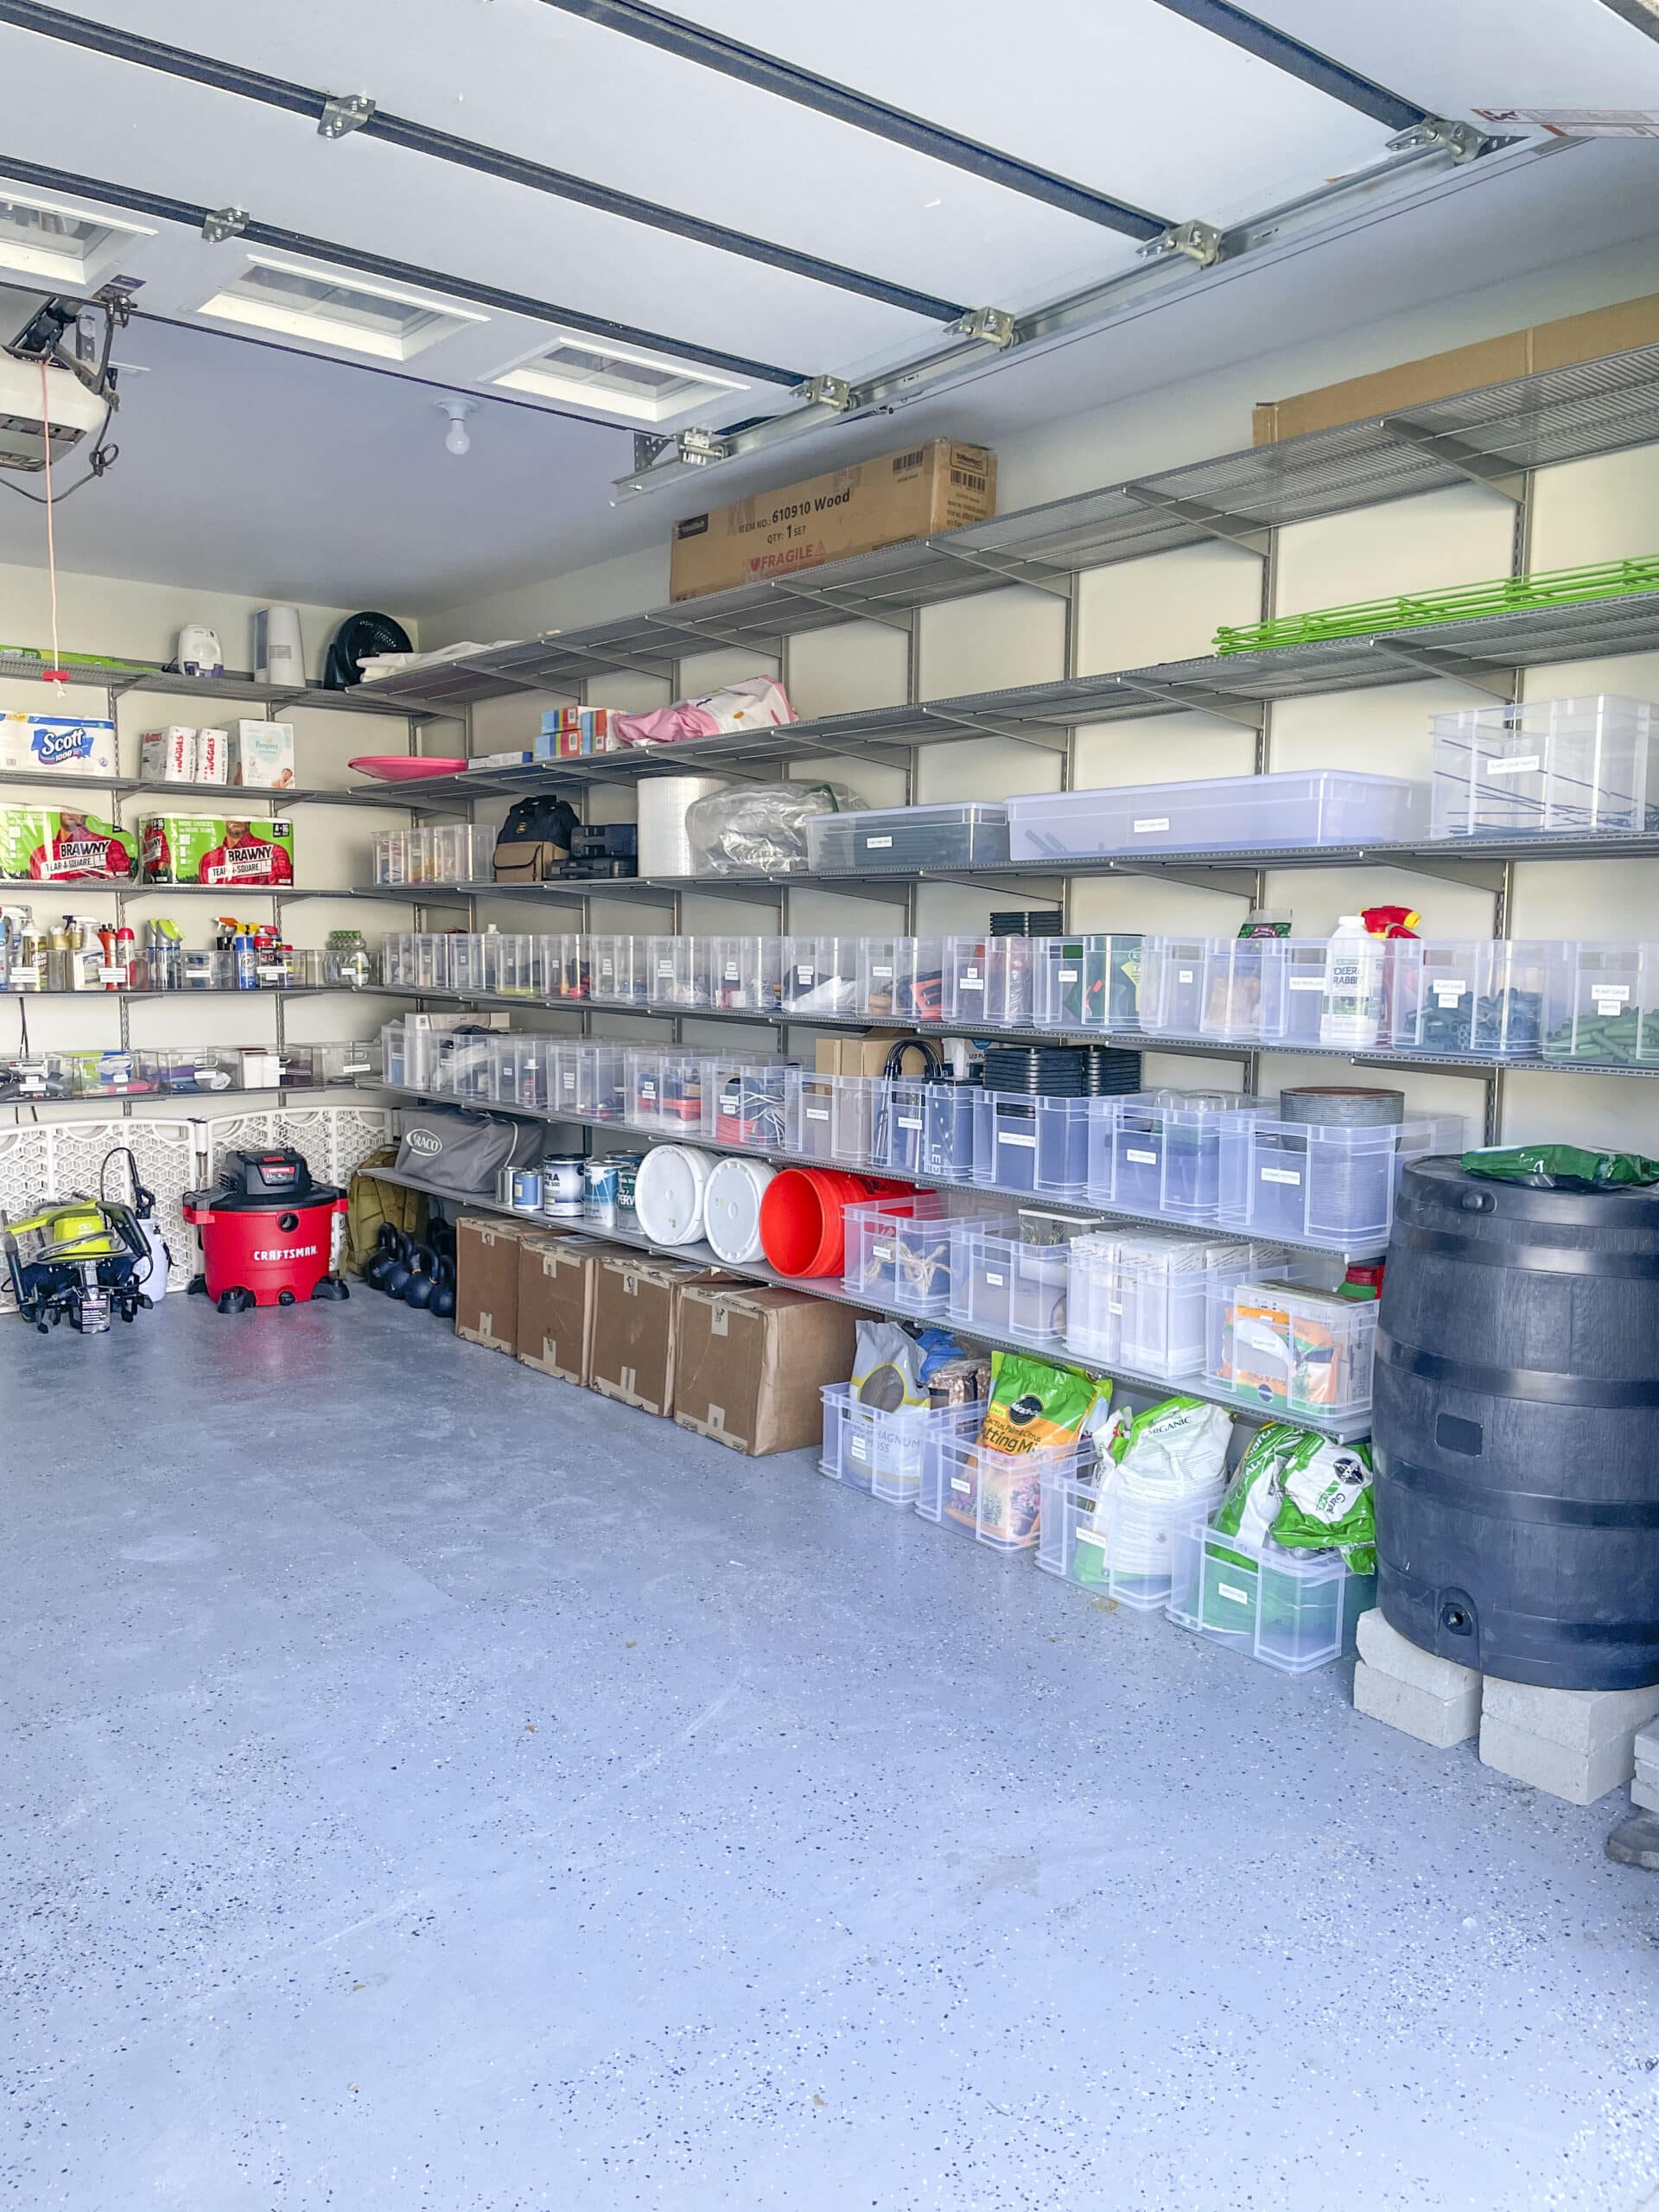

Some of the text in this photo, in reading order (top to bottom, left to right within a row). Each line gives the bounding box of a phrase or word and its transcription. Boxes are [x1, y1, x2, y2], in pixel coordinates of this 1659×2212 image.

[739, 522, 756, 534] ITEM
[772, 501, 810, 523] 610910
[814, 487, 850, 512] Wood
[767, 525, 806, 543] QTY: 1 SET
[760, 544, 813, 569] FRAGILE
[41, 728, 85, 755] Scott
[55, 750, 73, 762] 1000
[60, 841, 109, 857] BRAWNY
[228, 846, 273, 862] BRAWNY
[1333, 966, 1357, 976] DEER
[1332, 976, 1361, 985] RABBI
[254, 1245, 317, 1262] CRAFTSMAN
[1023, 1430, 1041, 1442] Citrus
